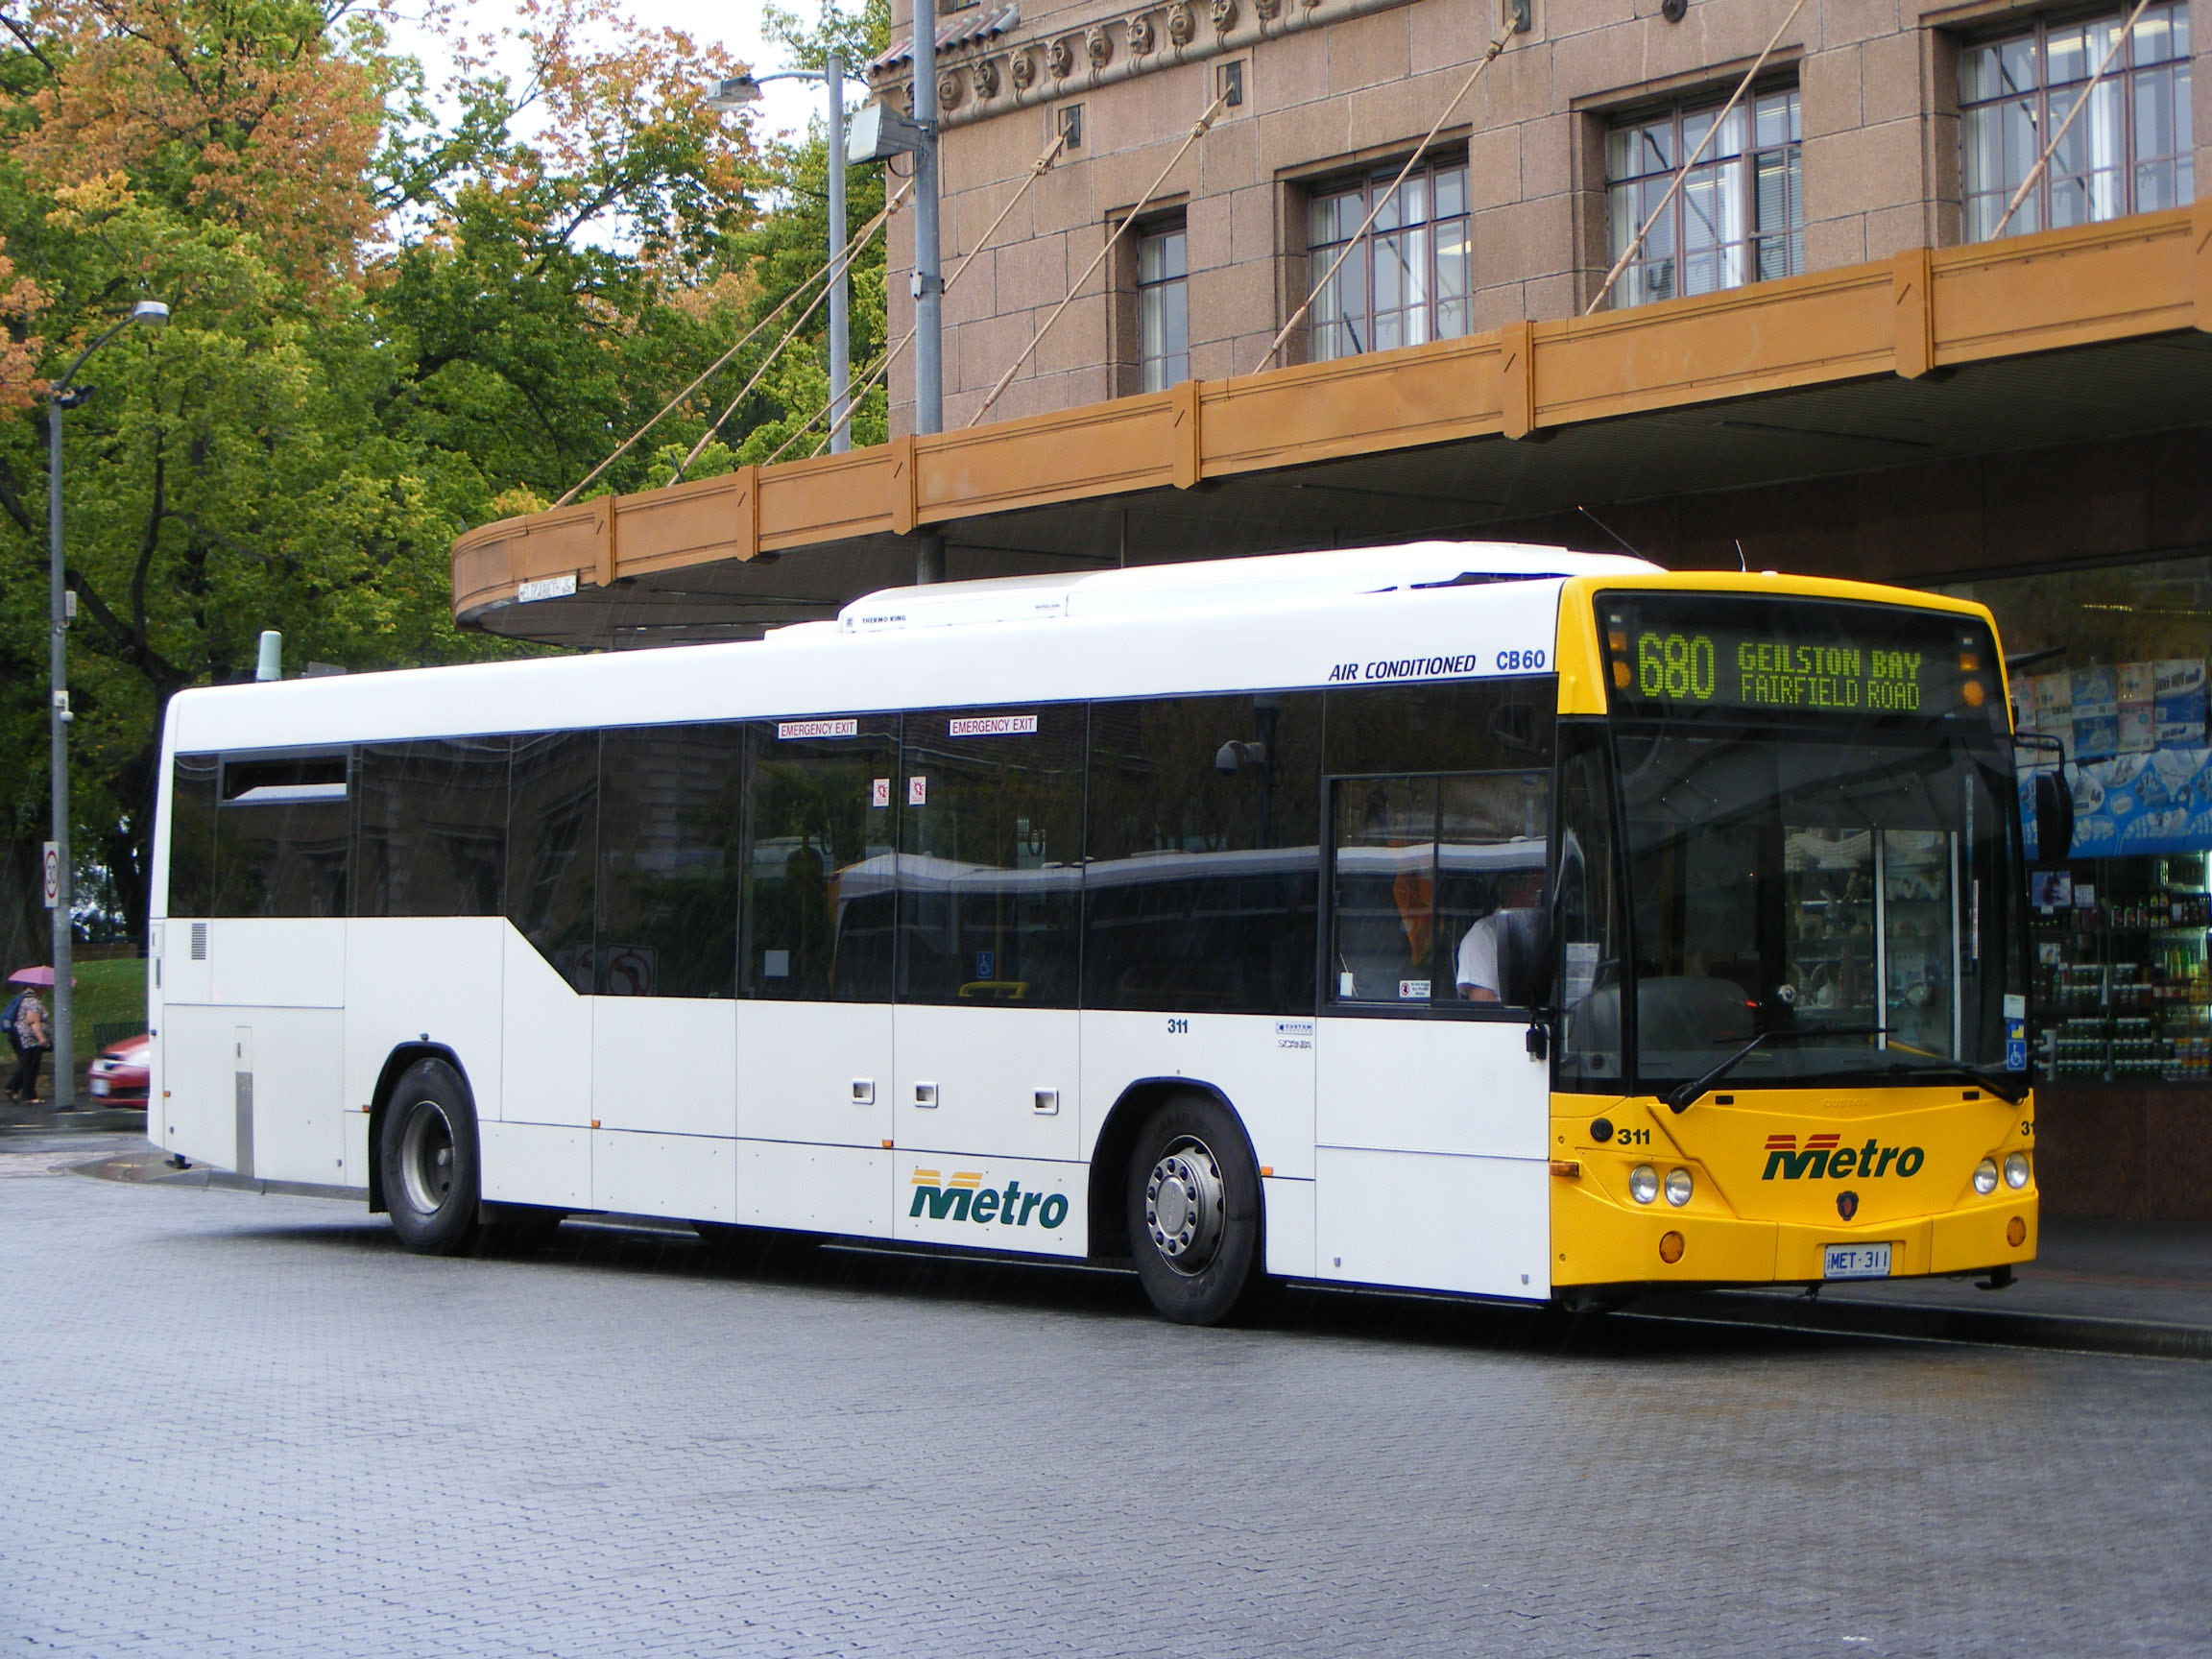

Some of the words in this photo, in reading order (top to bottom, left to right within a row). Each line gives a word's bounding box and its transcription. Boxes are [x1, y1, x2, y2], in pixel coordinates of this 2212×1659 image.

[1329, 663, 1358, 681] AIR
[1365, 655, 1476, 679] CONDITIONED
[1638, 632, 1715, 699] 680
[1738, 642, 1861, 677] GEILSTON
[1871, 649, 1920, 679] BAY
[1740, 674, 1859, 707] FAIRFIELD
[1867, 680, 1919, 710] ROAD
[781, 722, 833, 737] EMERGENCY
[835, 721, 855, 734] EXIT
[952, 719, 1010, 734] EMERGENCY
[1013, 717, 1035, 731] EXIT
[1167, 1019, 1188, 1033] 311
[1618, 1129, 1650, 1145] 311
[1762, 1134, 1925, 1180] Metro
[909, 1168, 1069, 1229] Metro
